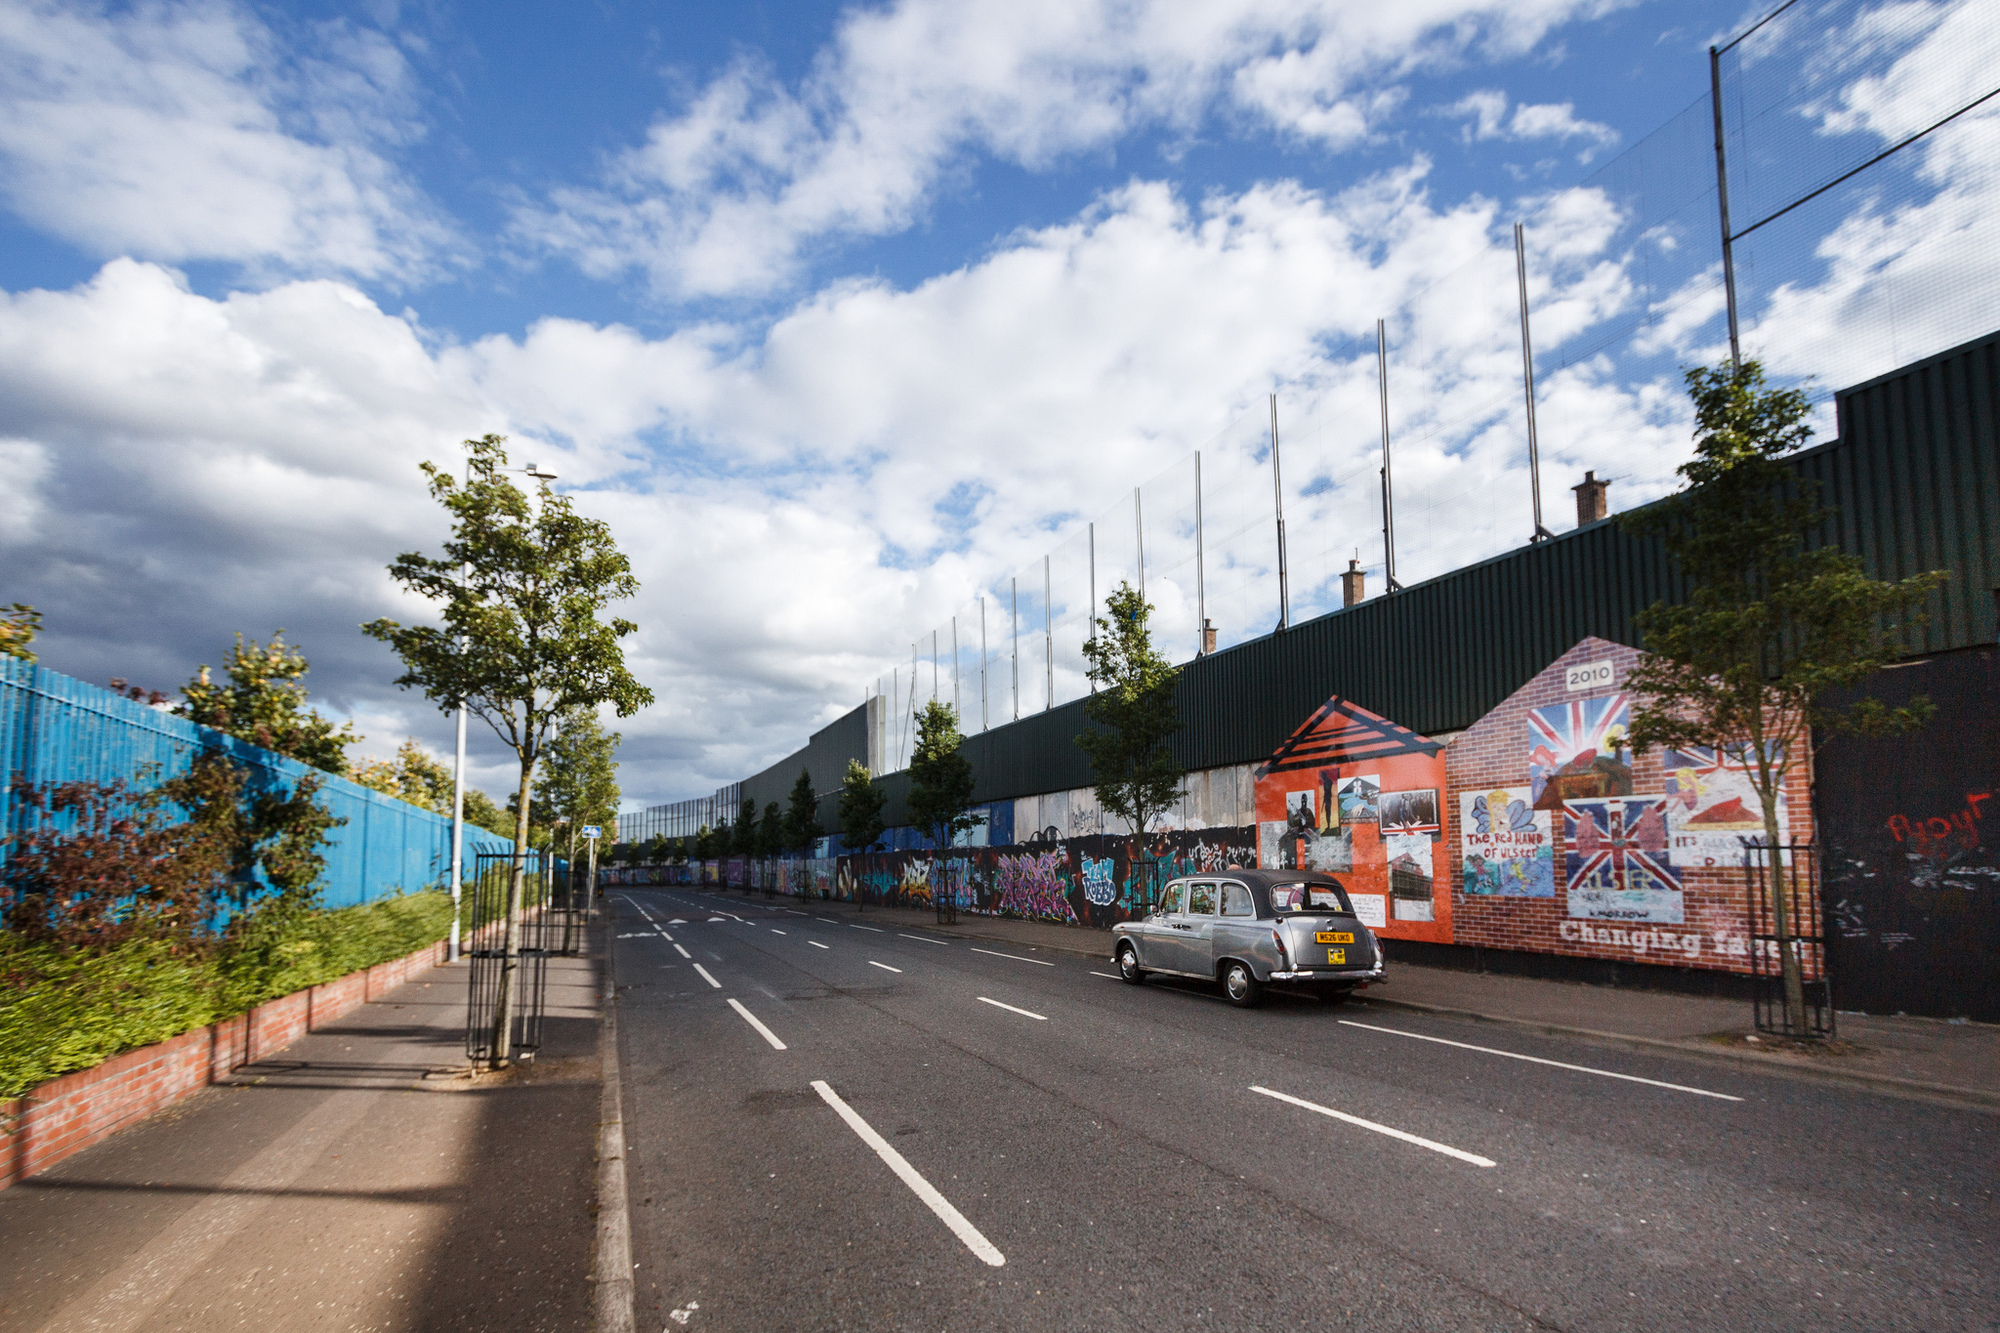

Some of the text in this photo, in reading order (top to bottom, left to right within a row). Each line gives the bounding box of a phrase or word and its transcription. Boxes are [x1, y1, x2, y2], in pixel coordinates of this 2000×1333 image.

[1570, 666, 1610, 685] 2010
[1514, 832, 1543, 845] HAND
[1483, 847, 1497, 859] OF
[1559, 920, 1701, 958] Changing
